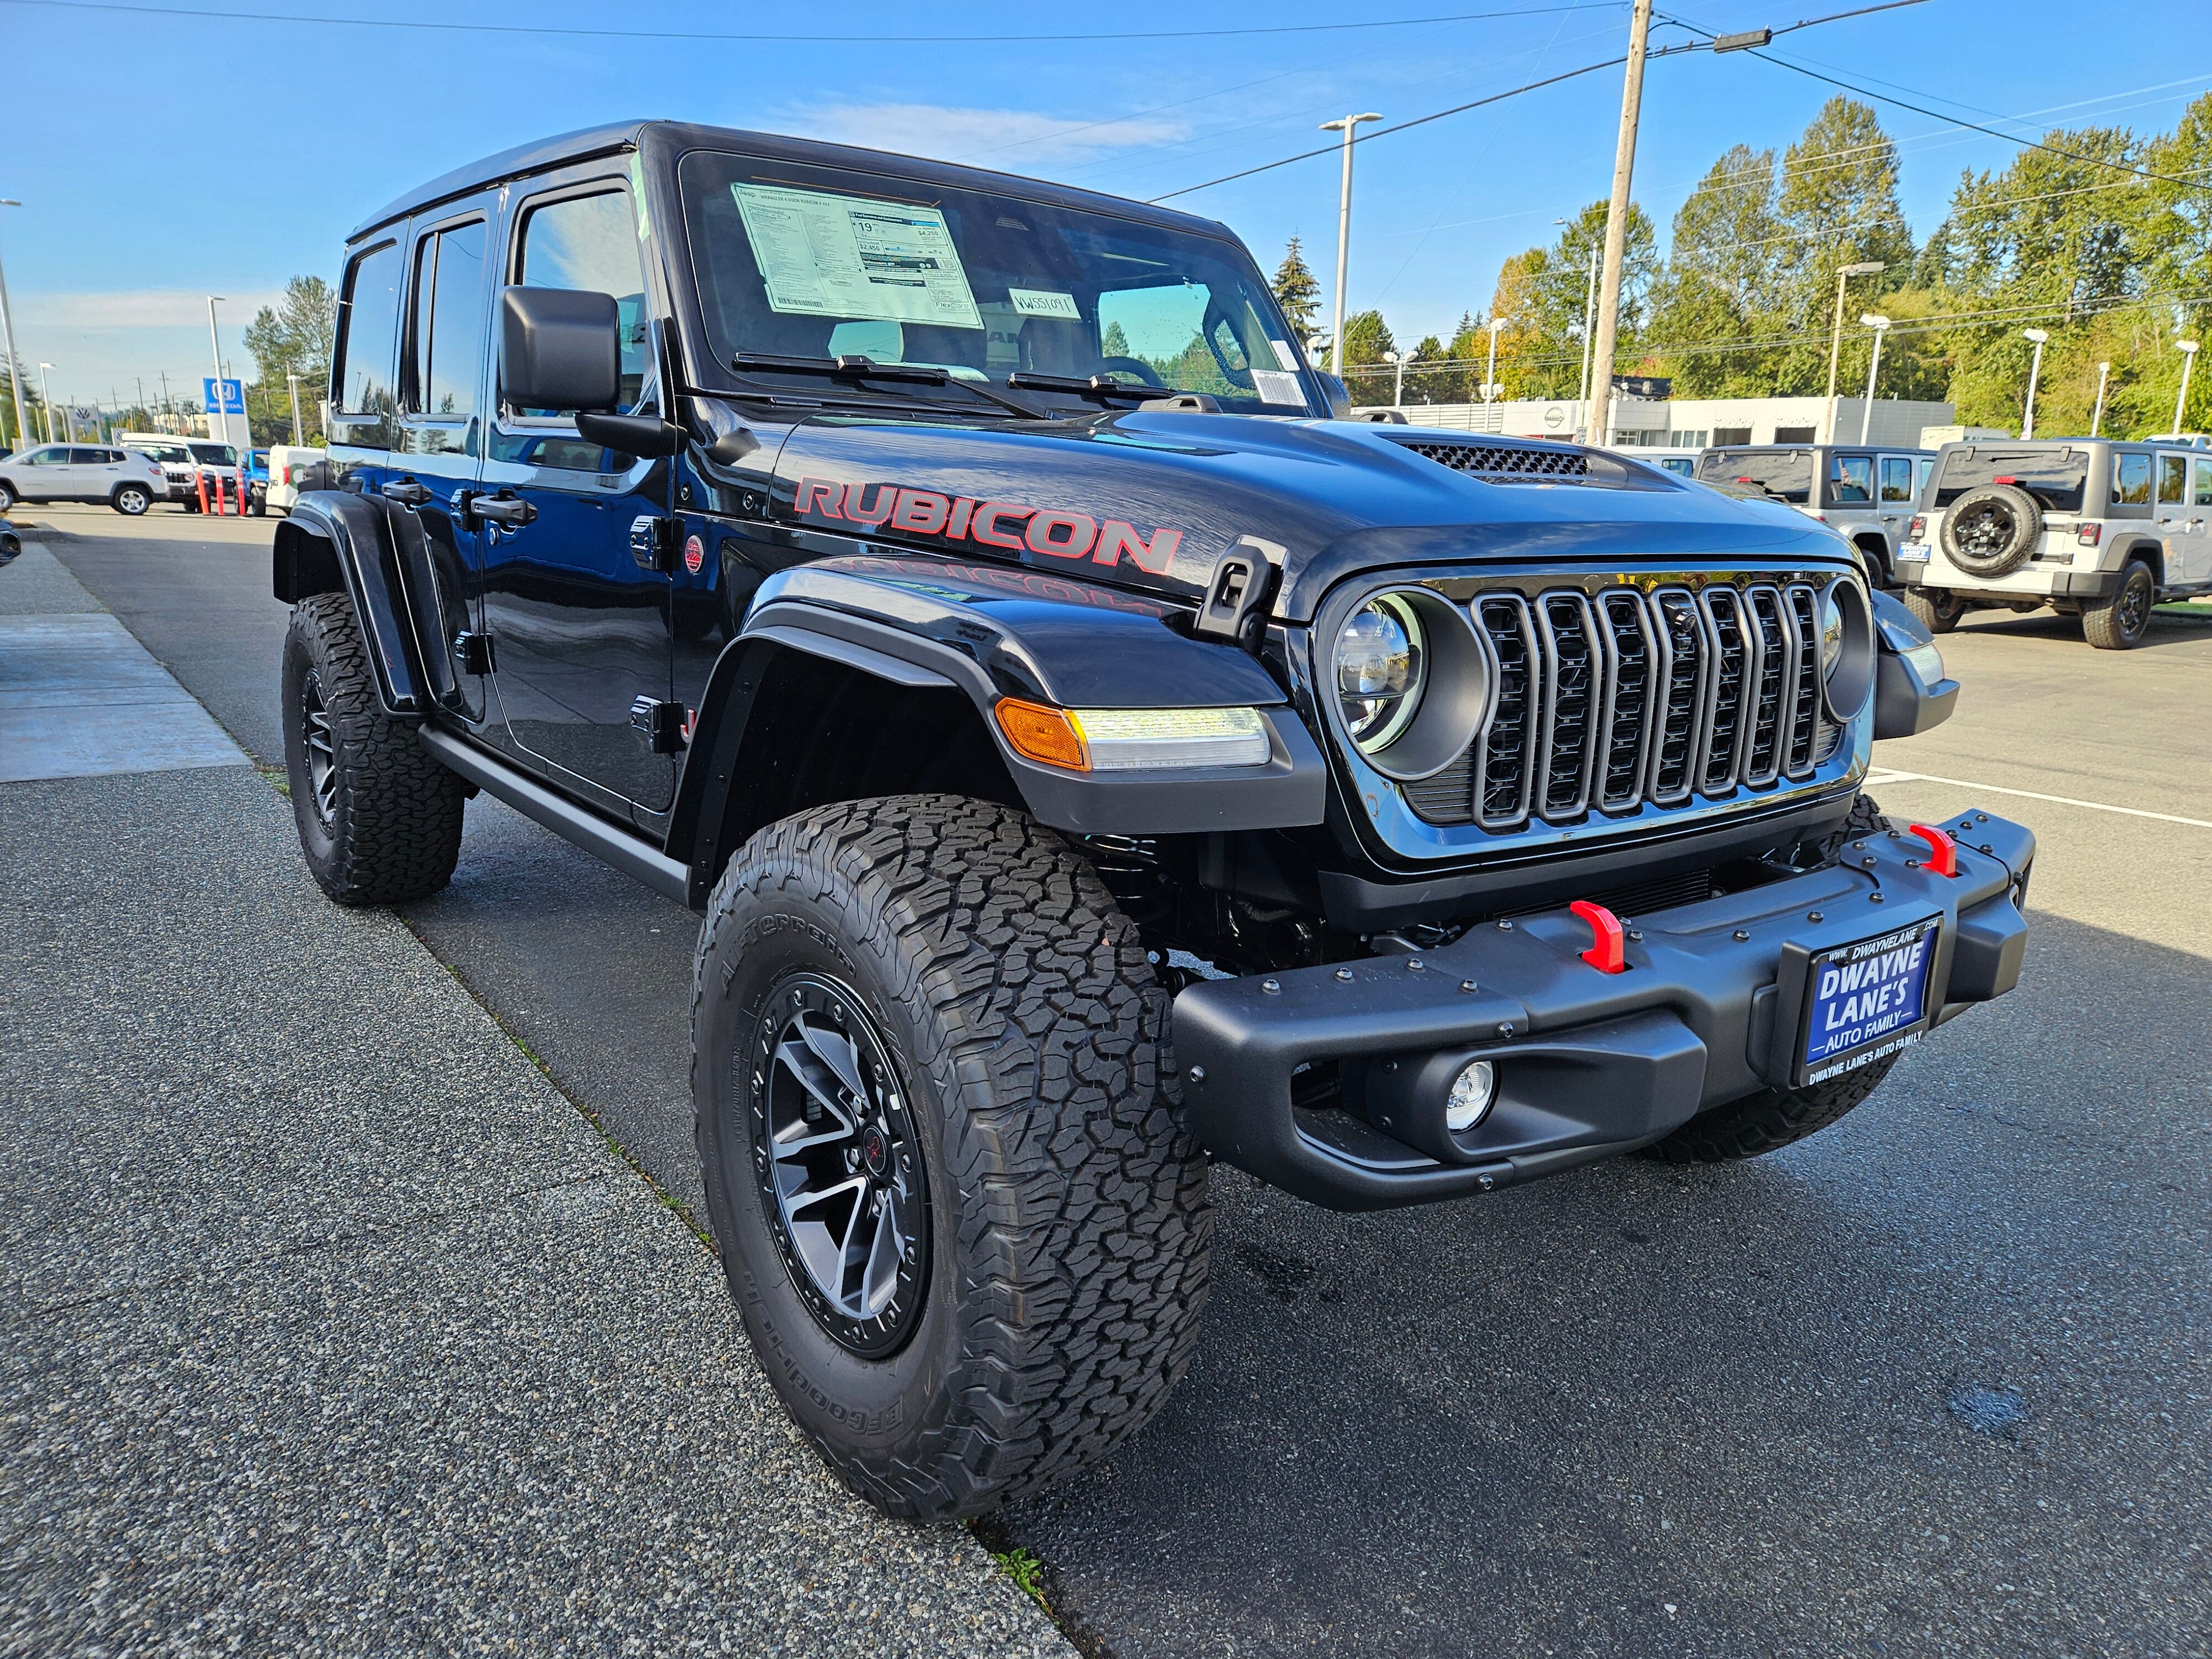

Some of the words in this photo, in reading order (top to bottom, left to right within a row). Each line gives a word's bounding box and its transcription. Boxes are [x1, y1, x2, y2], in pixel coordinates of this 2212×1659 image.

[859, 222, 872, 232] 19
[794, 476, 1183, 576] RUBICON
[1819, 941, 1924, 1001] DWAYNE
[1851, 928, 1917, 960] DWAYNELANE
[1825, 977, 1908, 1031] LANE'S
[1809, 1062, 1844, 1085] DWAYNE
[1846, 1051, 1874, 1069] LANE'S
[1874, 1040, 1895, 1060] AUTO
[1895, 1030, 1923, 1051] FAMILY
[1825, 1027, 1861, 1053] AUTO
[1864, 1010, 1902, 1039] FAMILY
